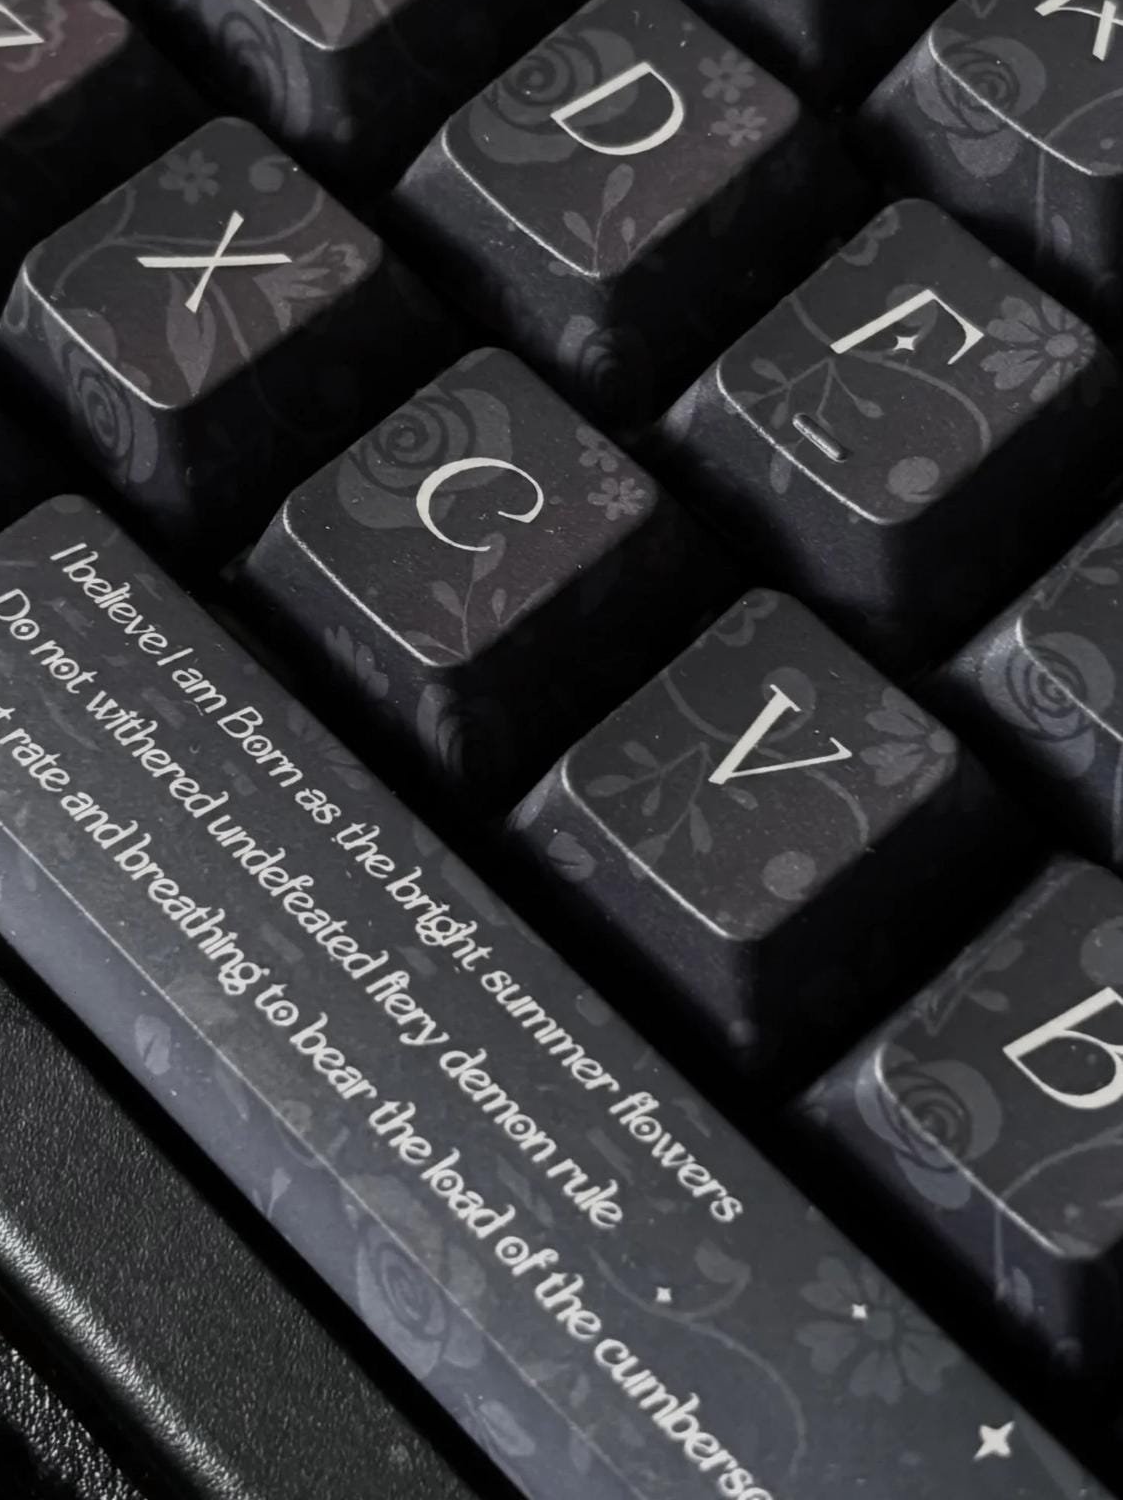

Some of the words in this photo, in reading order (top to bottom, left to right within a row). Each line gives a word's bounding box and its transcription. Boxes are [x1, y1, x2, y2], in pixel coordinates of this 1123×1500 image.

[549, 60, 684, 156] D
[136, 210, 293, 313] X
[829, 288, 985, 366] F
[415, 456, 545, 552] C
[708, 683, 853, 786] V
[29, 640, 99, 695] not
[85, 689, 230, 819] withered
[206, 814, 390, 980] undefeated
[438, 1047, 558, 1163] demon
[545, 1157, 624, 1230] rule
[171, 667, 227, 714] am
[216, 706, 304, 788] Born
[294, 788, 342, 825] as
[335, 821, 396, 878] the
[385, 866, 493, 972] bright
[480, 970, 620, 1093] summer
[608, 1091, 744, 1223] flowers
[59, 791, 139, 850] and
[113, 832, 271, 996] breathing
[254, 982, 300, 1028] to
[288, 1010, 378, 1100] bear
[368, 1100, 433, 1165] the
[420, 1146, 517, 1239] load
[493, 1235, 560, 1277] of
[533, 1271, 603, 1342] the
